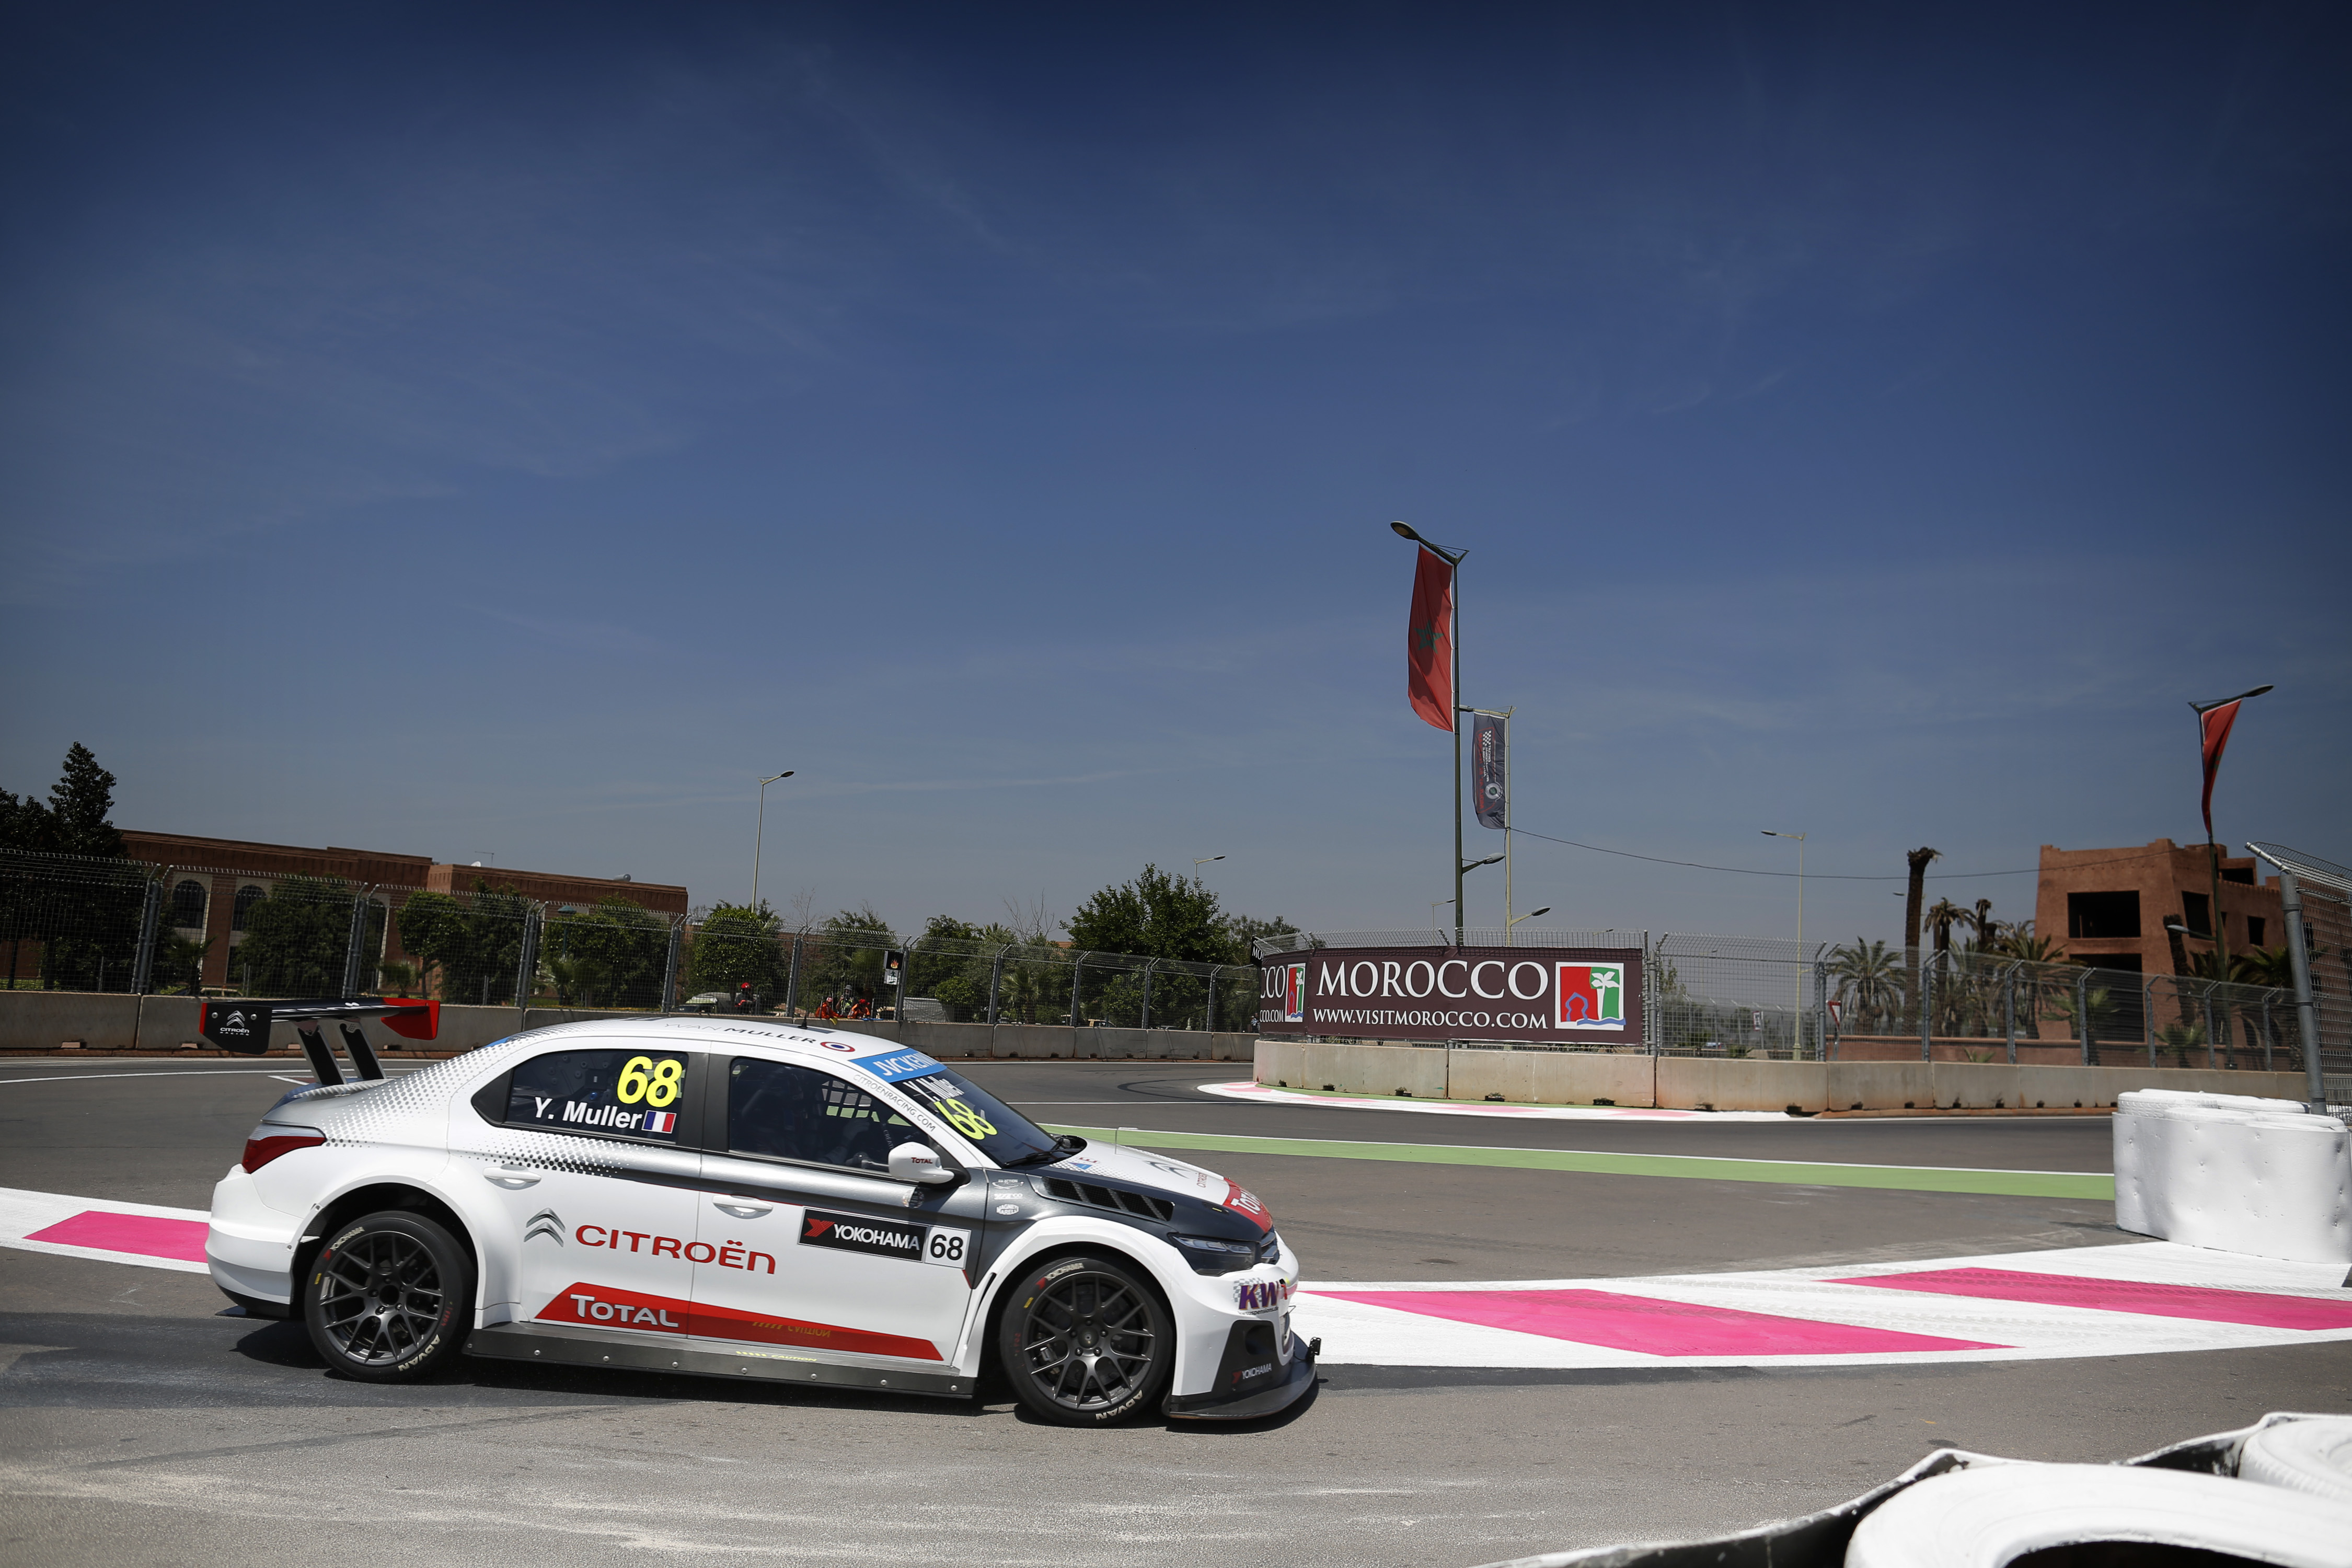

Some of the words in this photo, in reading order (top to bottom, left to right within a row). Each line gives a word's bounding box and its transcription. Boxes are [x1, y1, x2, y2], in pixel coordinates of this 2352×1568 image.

[1316, 960, 1549, 1000] MOROCCO
[665, 1023, 722, 1031] YVAN
[723, 1028, 816, 1044] MULLER
[1312, 1008, 1548, 1029] WWW.VISITMOROCCO.COM
[617, 1056, 683, 1108] 68
[535, 1097, 555, 1120] Y.
[562, 1100, 643, 1129] Muller
[853, 1075, 936, 1132] CITROENRACING.COM
[933, 1098, 998, 1140] 68
[330, 1226, 365, 1251] YOKOHAMA
[575, 1224, 776, 1275] CITROËN
[834, 1224, 920, 1250] YOKOHAMA
[930, 1234, 964, 1261] 68
[1045, 1263, 1085, 1280] YOKOHAMA
[570, 1294, 679, 1328] TOTAL
[398, 1334, 440, 1371] ADVAN
[1096, 1389, 1143, 1420] ADVAN
